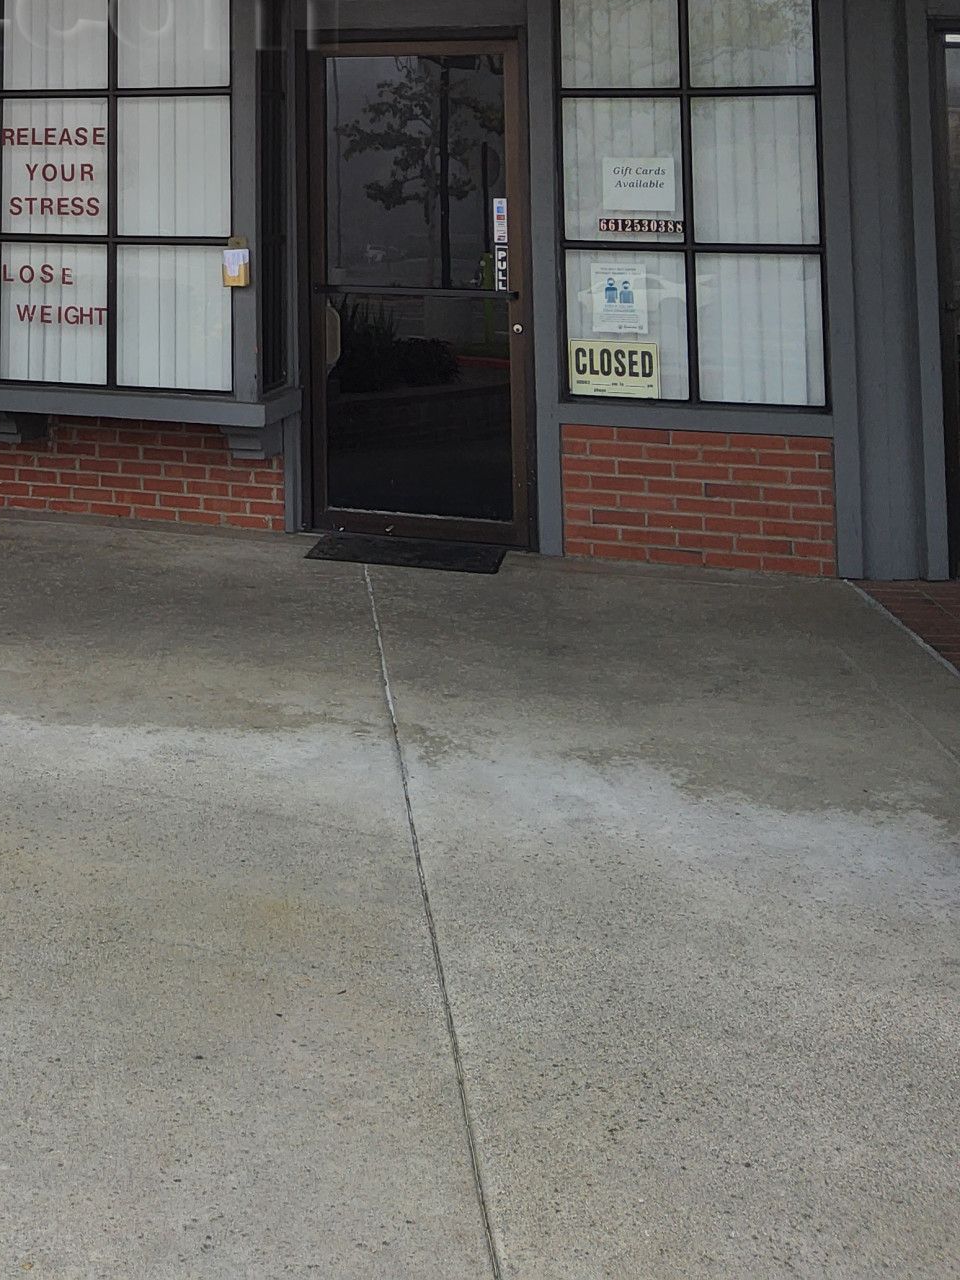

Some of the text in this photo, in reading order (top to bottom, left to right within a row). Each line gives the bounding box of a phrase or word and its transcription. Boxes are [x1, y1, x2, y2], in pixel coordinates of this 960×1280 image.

[2, 127, 106, 146] RELEASE
[25, 163, 95, 183] YOUR
[613, 166, 666, 177] Gift Cards
[614, 179, 665, 189] Available
[9, 197, 101, 216] STRESS
[599, 219, 683, 234] 6612530388
[2, 264, 74, 285] LOSE
[496, 250, 507, 291] PULL
[16, 304, 108, 325] WEIGHT
[574, 347, 654, 378] CLOSED
